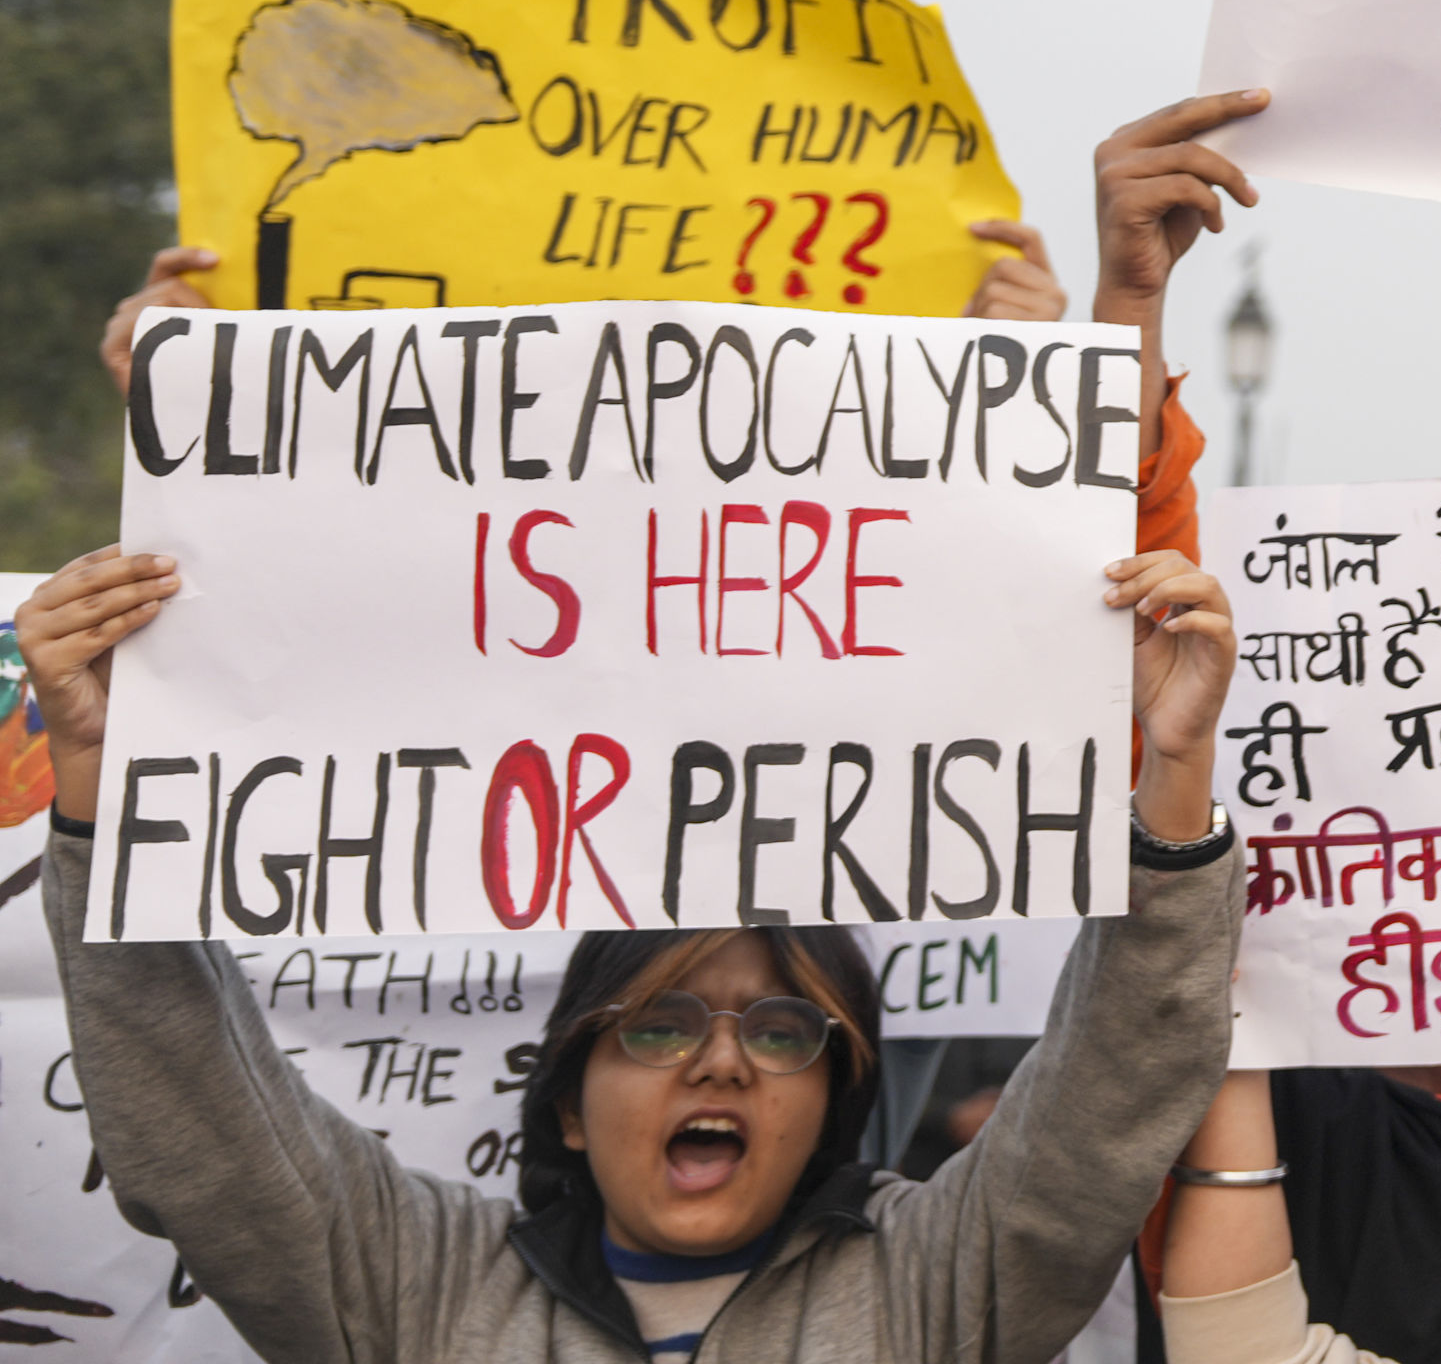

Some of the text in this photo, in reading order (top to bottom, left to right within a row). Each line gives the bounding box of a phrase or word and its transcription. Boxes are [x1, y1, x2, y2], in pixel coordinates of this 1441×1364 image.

[528, 75, 709, 173] OVER
[127, 315, 1141, 492] CLIMATE APOCALYPSE
[471, 501, 912, 660] IS HERE
[1243, 513, 1402, 592] जंगल
[1239, 612, 1370, 686] साथी
[1225, 701, 1329, 807] ही
[110, 732, 1096, 941] FIGHT OR PERISH
[343, 1037, 463, 1107] THE
